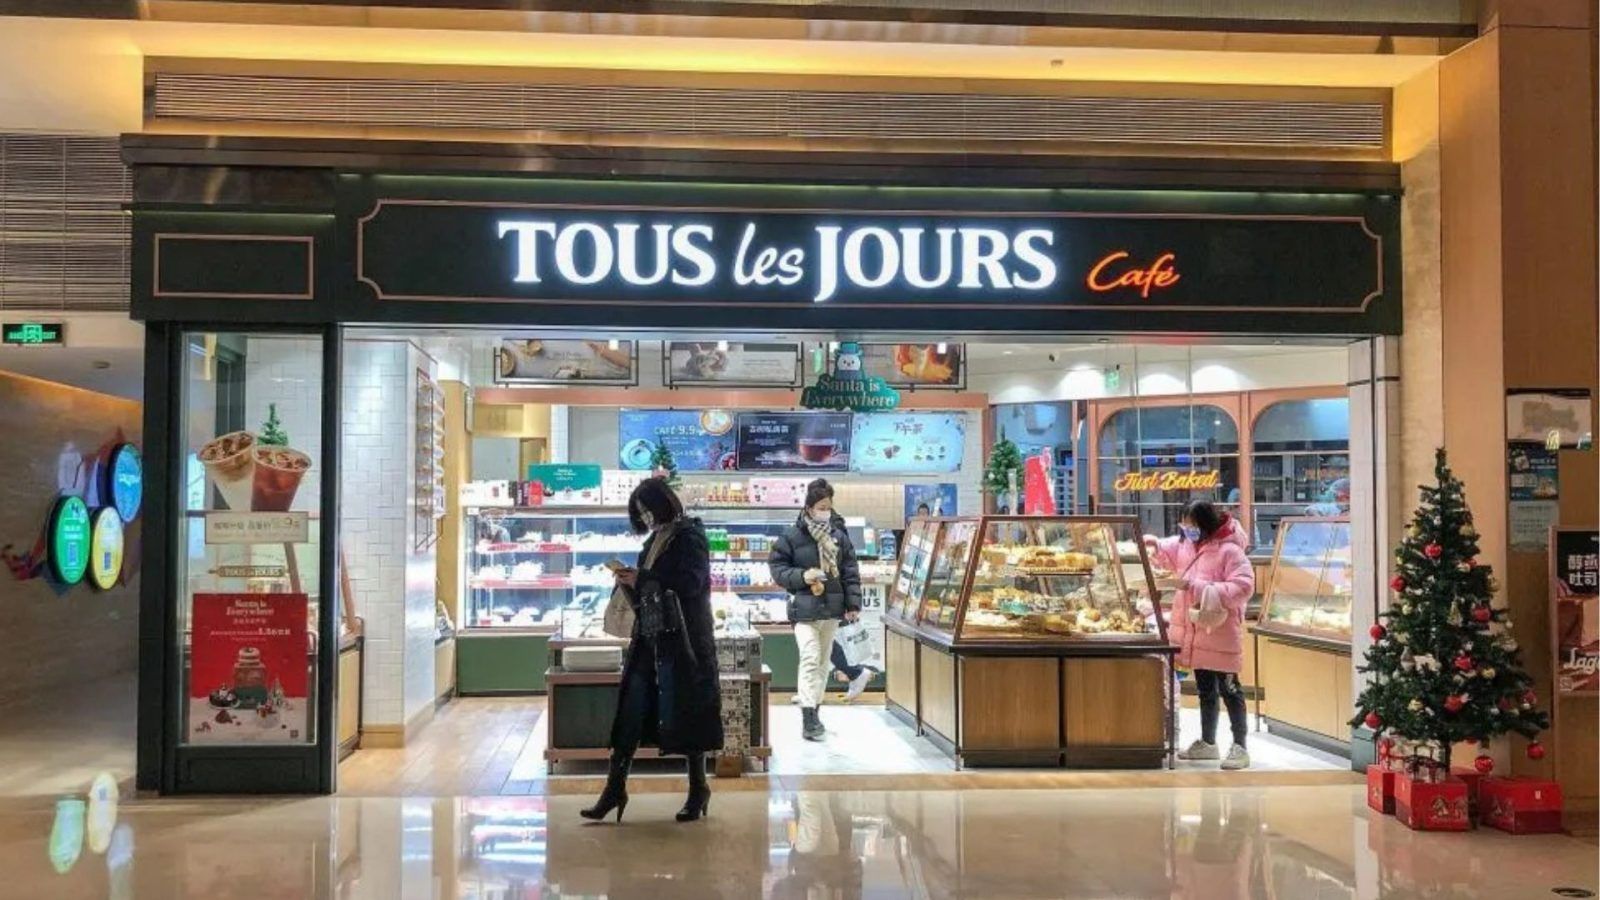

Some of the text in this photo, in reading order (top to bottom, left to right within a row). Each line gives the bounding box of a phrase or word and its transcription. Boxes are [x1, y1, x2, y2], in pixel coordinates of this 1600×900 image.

[498, 221, 1181, 303] TOUS les JOURS Café
[820, 378, 880, 392] Santa is
[804, 389, 894, 410] Everywhere
[1114, 469, 1219, 491] Just Baked
